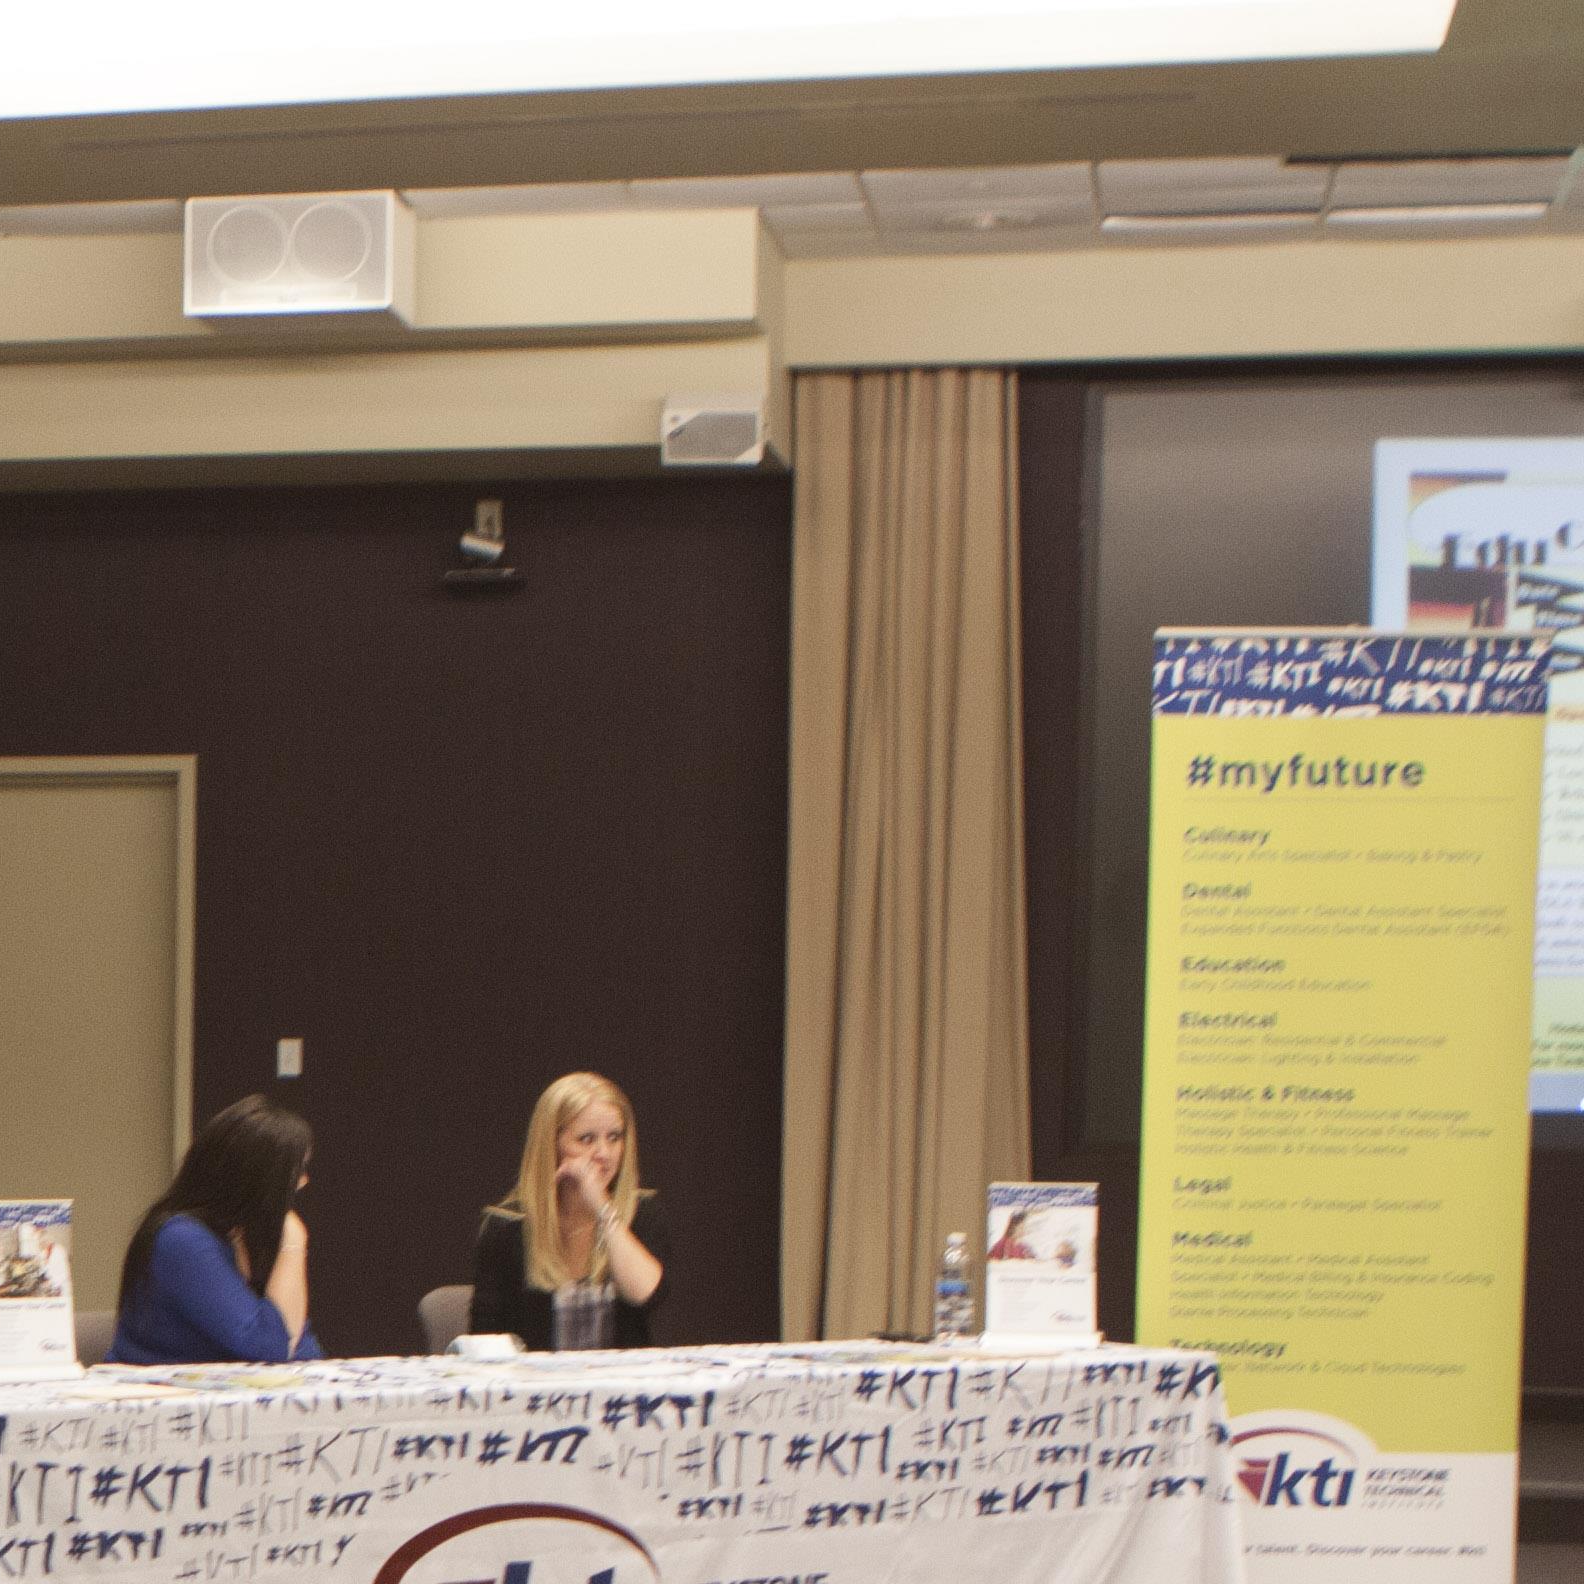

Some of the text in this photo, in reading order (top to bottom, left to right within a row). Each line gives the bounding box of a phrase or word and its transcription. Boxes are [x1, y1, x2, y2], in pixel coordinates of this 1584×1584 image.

[1186, 752, 1426, 794] #myfuture
[1183, 826, 1272, 847] Culinary
[1181, 881, 1252, 899] Dental
[1180, 955, 1286, 973] Education
[1178, 1011, 1279, 1029] Electrical
[1176, 1085, 1356, 1102] Holistic & Fitness
[1172, 1176, 1232, 1195] Legal
[1171, 1230, 1253, 1248] Medical
[853, 1366, 960, 1411] #KTI
[601, 1389, 717, 1431] #KTI
[784, 1424, 893, 1478] #KTI
[89, 1455, 213, 1512] #KTI
[1263, 1451, 1357, 1507] kti
[65, 1526, 164, 1562] #KTI
